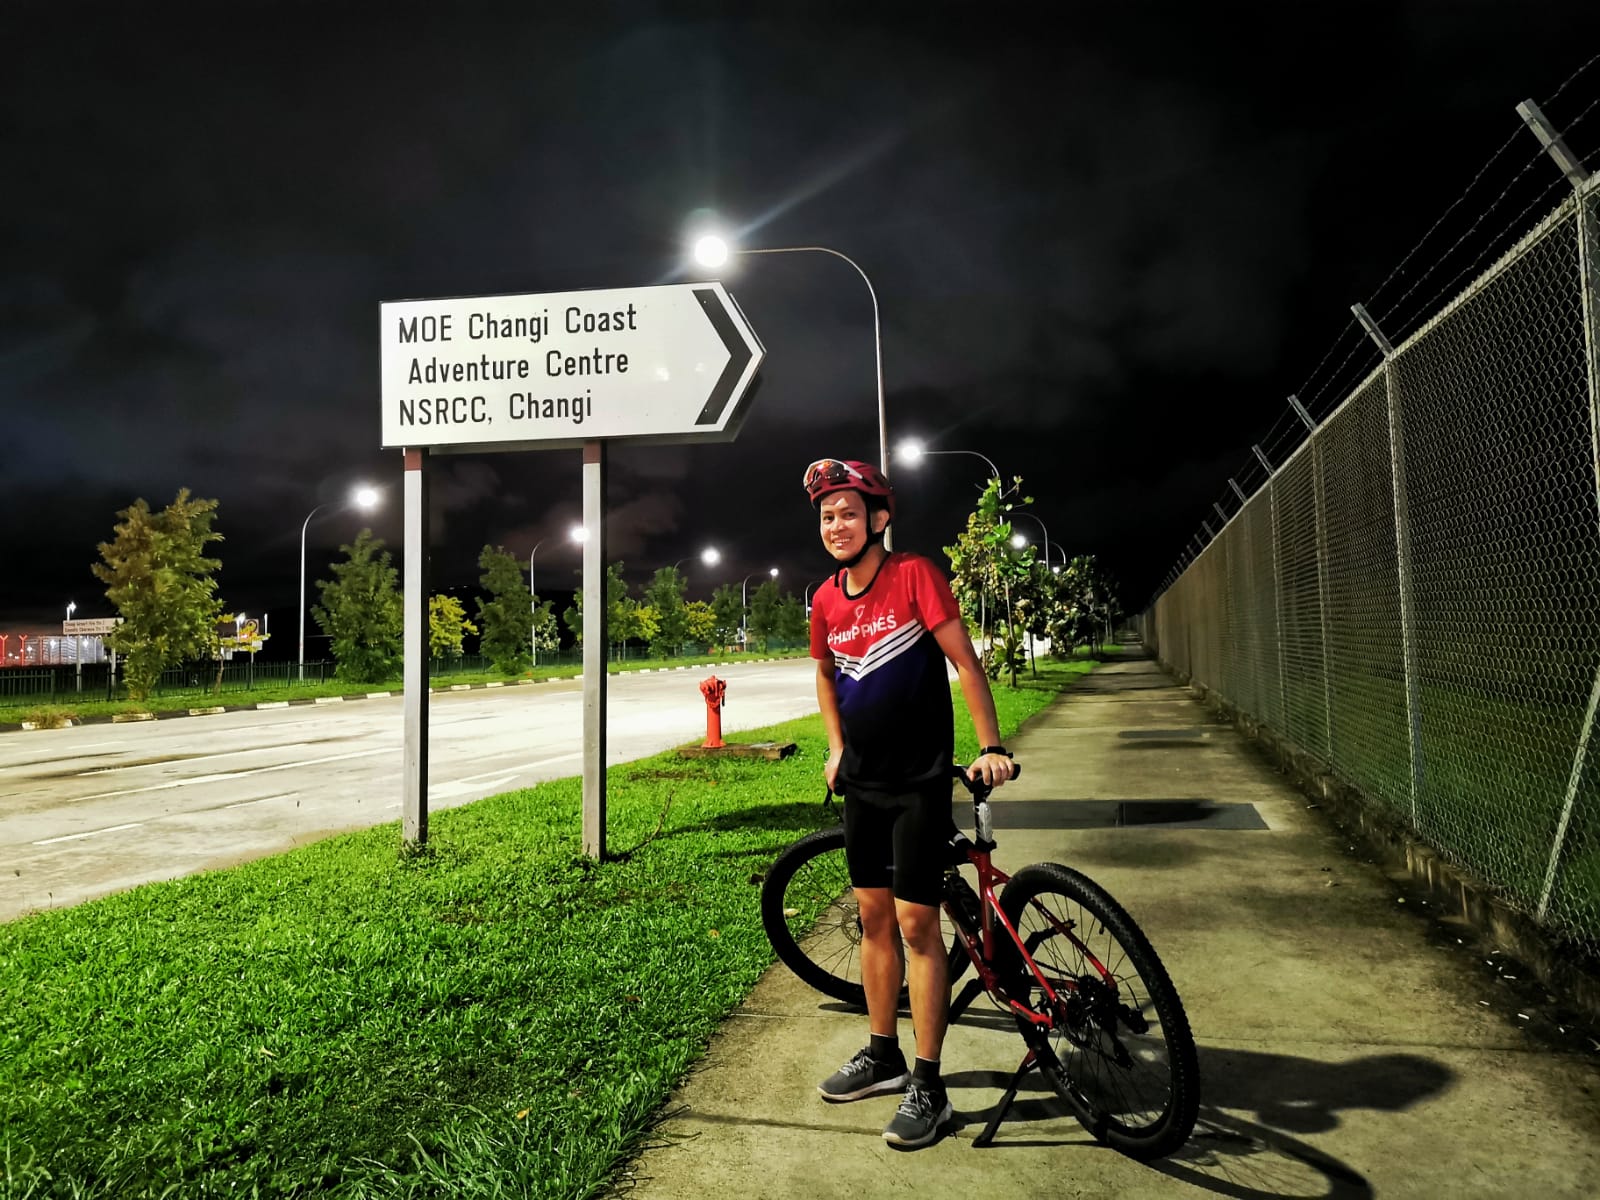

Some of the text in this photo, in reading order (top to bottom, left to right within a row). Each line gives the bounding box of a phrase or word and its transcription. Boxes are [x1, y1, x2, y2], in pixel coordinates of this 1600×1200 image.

[399, 303, 638, 344] MOE Changi Coast
[408, 347, 629, 385] Adventure Centre
[399, 389, 592, 426] NSRCC, Changi
